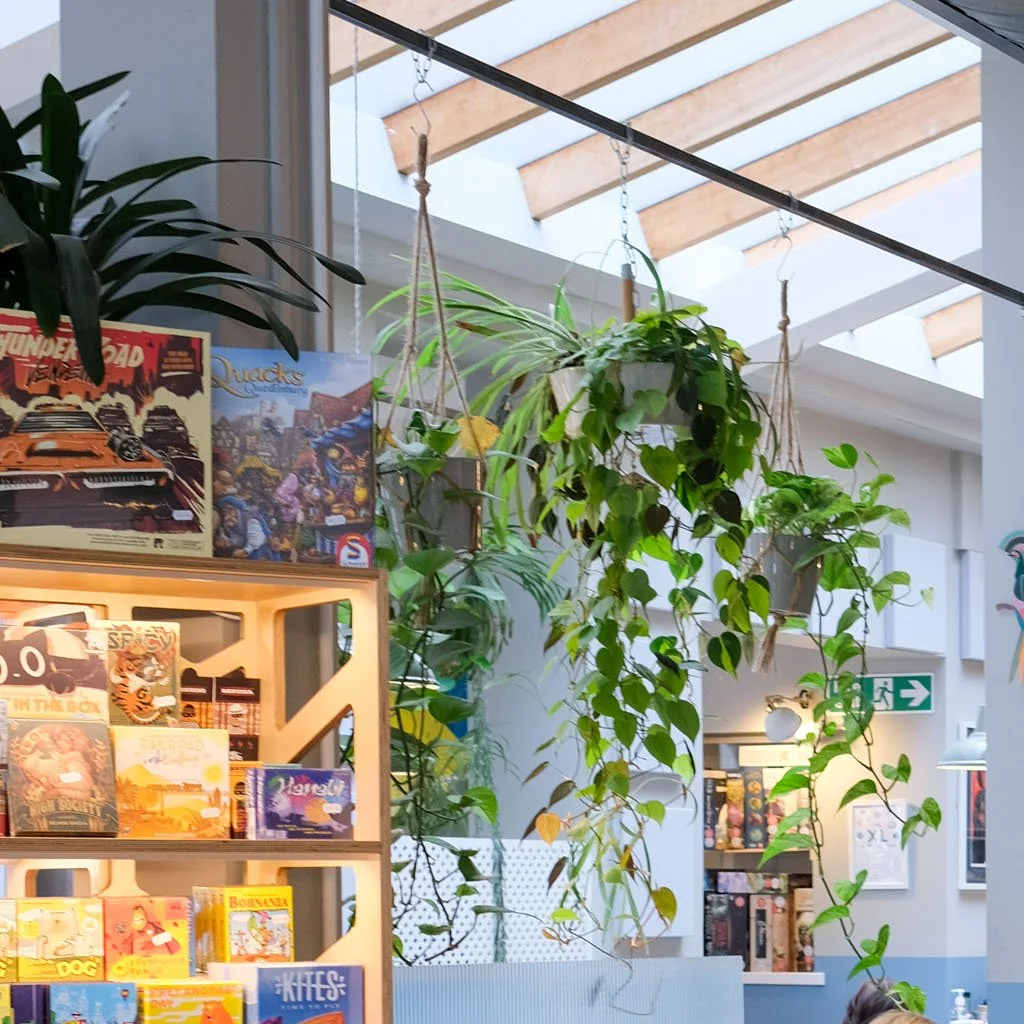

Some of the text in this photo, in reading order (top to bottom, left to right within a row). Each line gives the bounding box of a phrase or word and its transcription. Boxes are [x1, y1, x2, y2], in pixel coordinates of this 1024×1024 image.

[0, 331, 77, 362] HUNDER
[102, 337, 144, 368] OAD
[277, 776, 345, 797] Hanabi
[56, 959, 97, 977] DOG
[282, 970, 340, 1002] KITES
